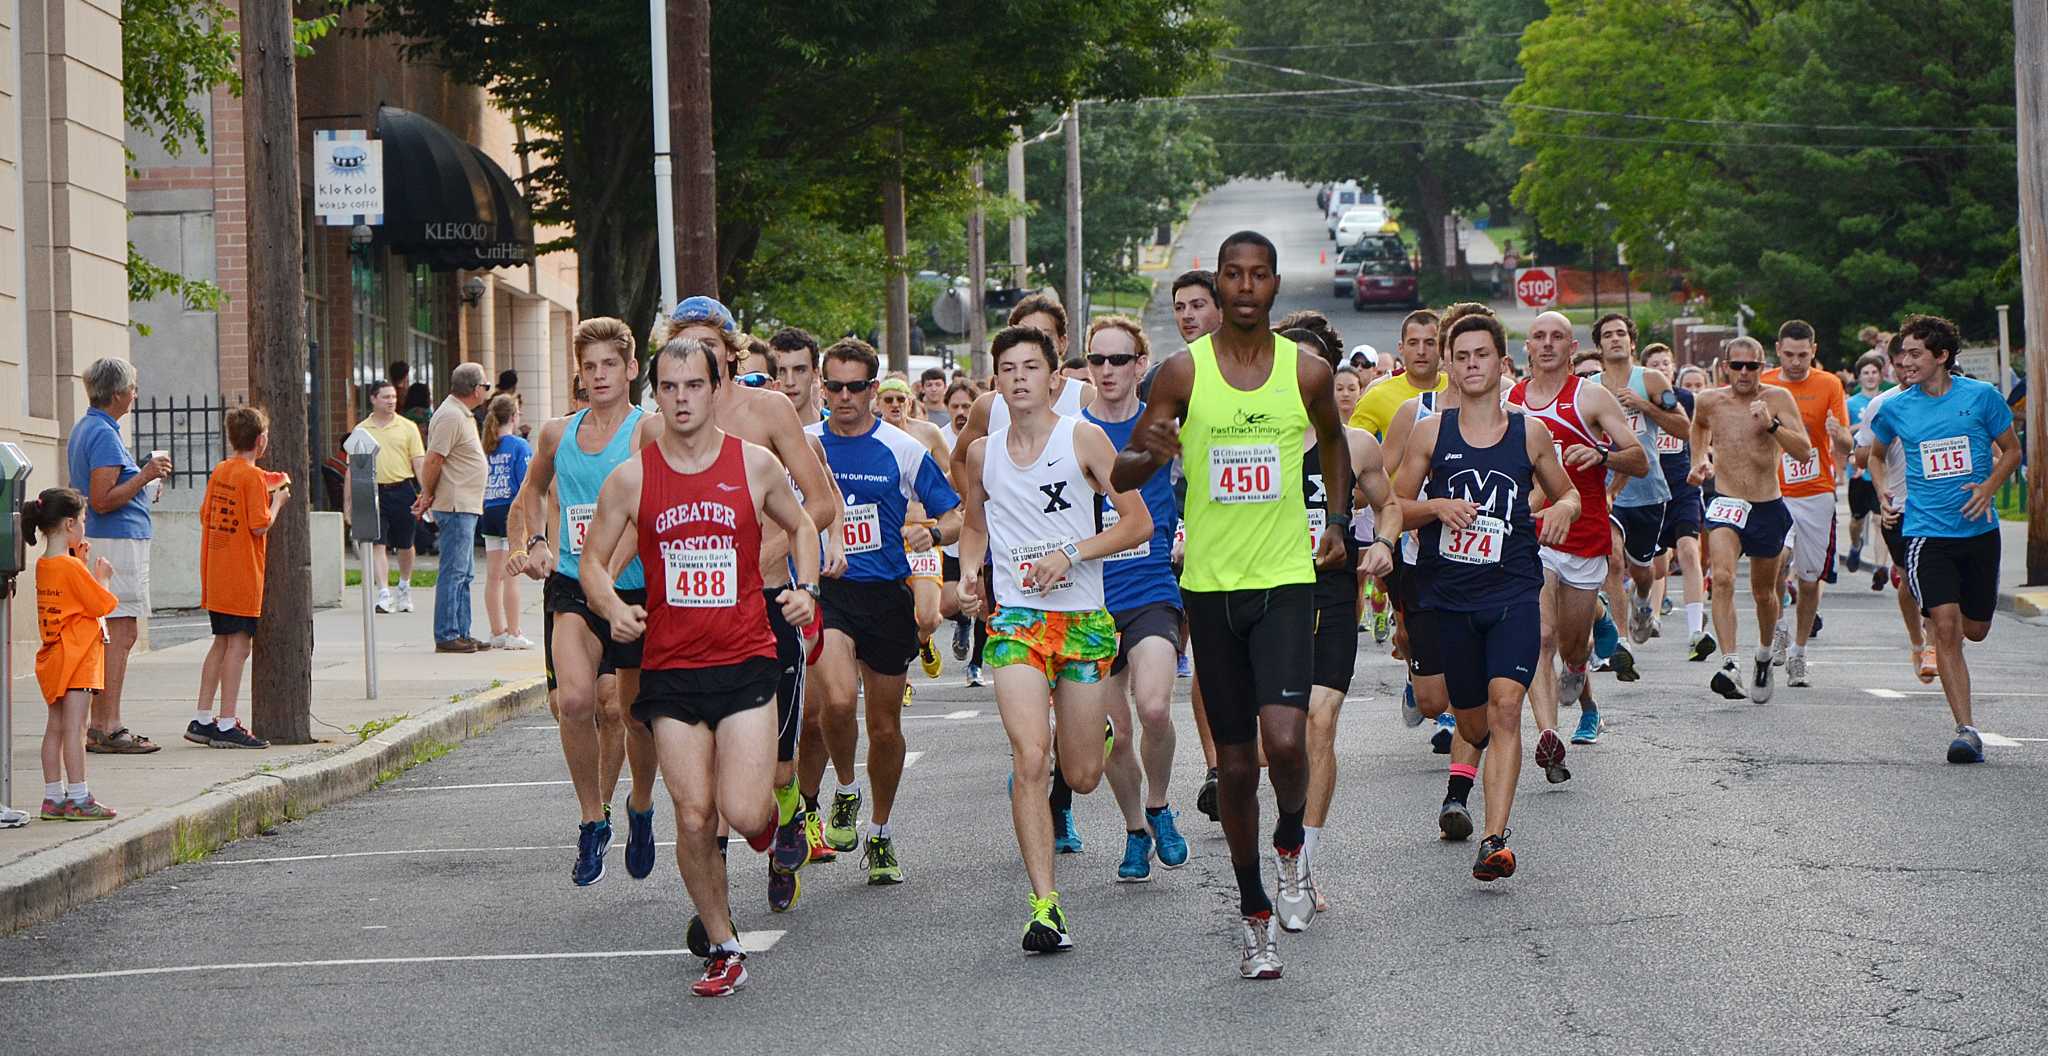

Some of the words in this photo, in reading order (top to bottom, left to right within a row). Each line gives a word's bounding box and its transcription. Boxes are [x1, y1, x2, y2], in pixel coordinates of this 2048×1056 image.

[424, 222, 488, 240] KLEKOLO
[1520, 280, 1553, 297] STOP
[1211, 426, 1280, 435] FastTrackTiming
[1254, 448, 1272, 456] Bank
[1930, 450, 1964, 472] 115
[1790, 460, 1813, 476] 387
[1220, 465, 1270, 493] 450
[1040, 481, 1072, 513] X
[656, 500, 736, 534] GREATER
[1713, 506, 1742, 522] 319
[843, 522, 871, 546] 60
[1019, 545, 1046, 553] Citizens
[1047, 540, 1063, 549] Bank
[1448, 530, 1492, 558] 374
[912, 559, 936, 572] 295
[676, 570, 725, 596] 488
